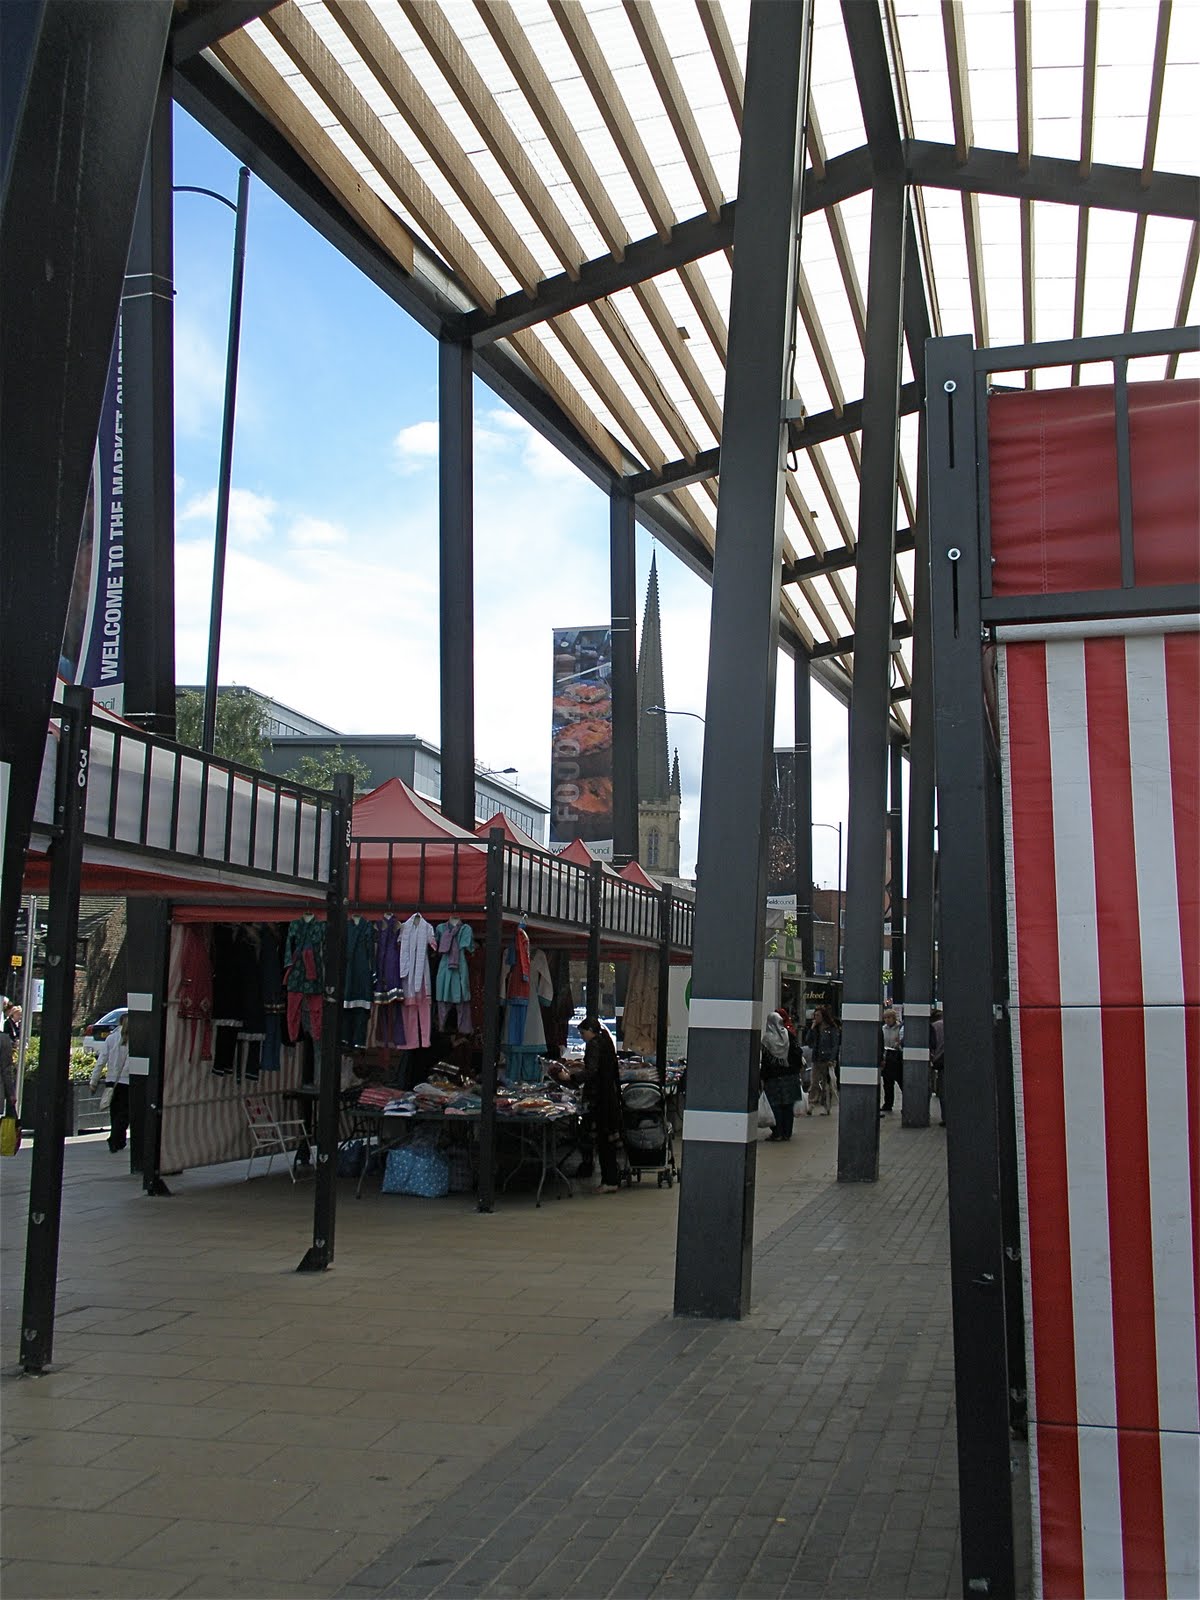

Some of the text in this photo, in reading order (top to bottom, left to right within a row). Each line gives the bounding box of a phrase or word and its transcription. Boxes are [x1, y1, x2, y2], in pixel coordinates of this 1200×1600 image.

[110, 502, 123, 540] THE
[108, 545, 124, 571] TO
[101, 576, 124, 680] WELCOME
[78, 749, 87, 787] 36
